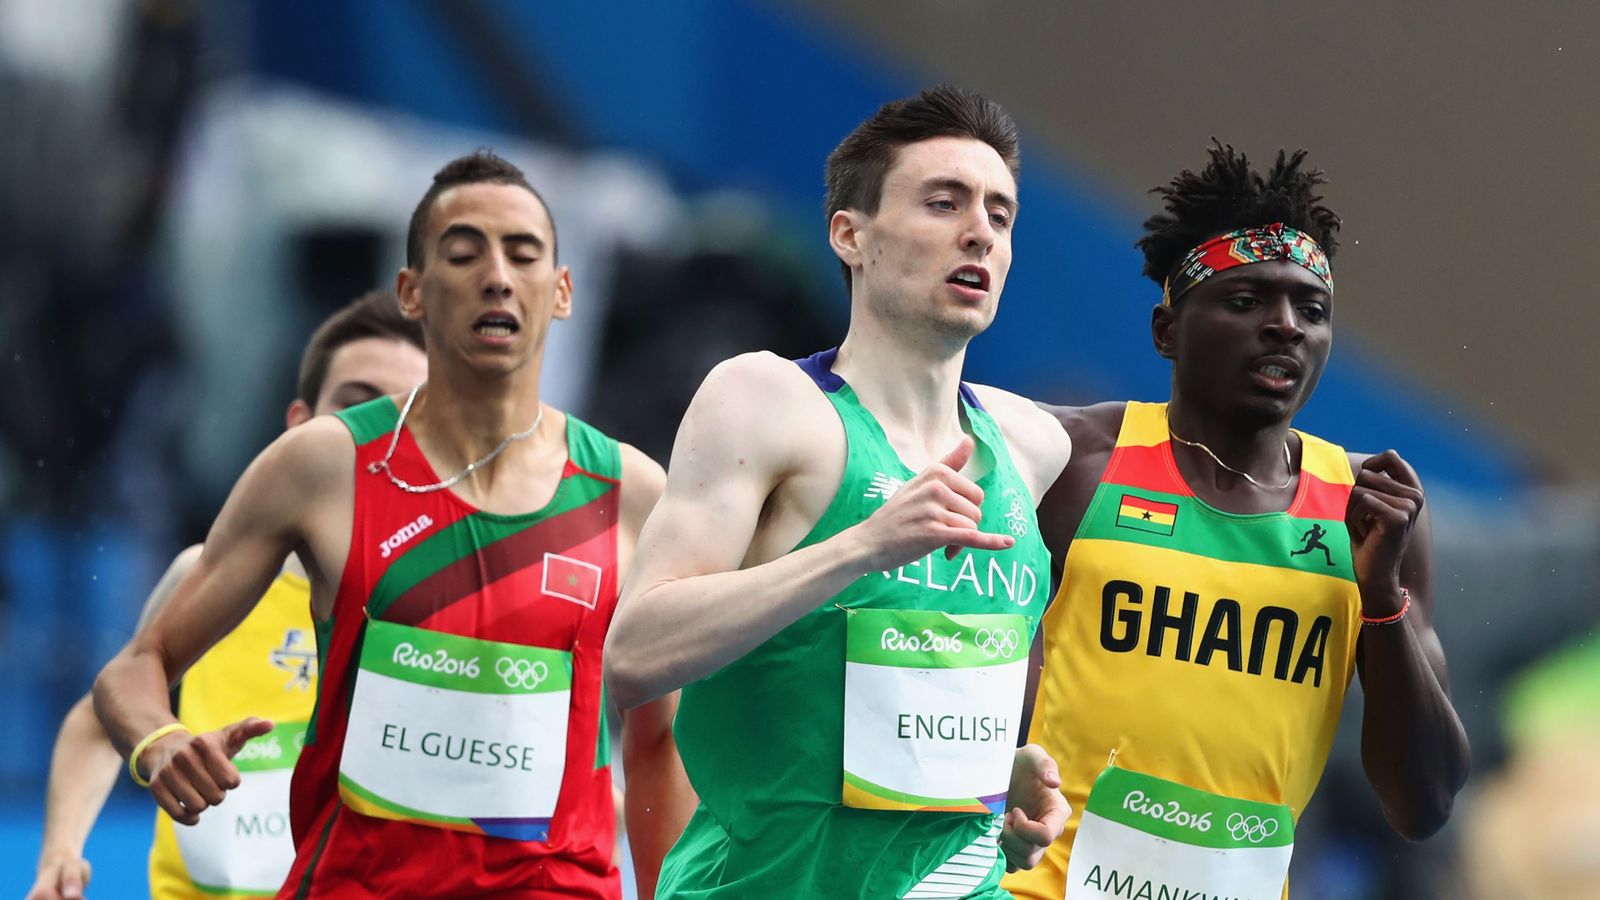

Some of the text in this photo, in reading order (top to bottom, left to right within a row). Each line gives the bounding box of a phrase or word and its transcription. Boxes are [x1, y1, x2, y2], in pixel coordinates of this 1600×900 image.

[863, 551, 1037, 607] ELAND
[880, 627, 964, 652] Rio2016
[1100, 579, 1332, 688] GHANA
[393, 642, 481, 678] Rio2016
[897, 713, 1007, 742] ENGLISH
[381, 724, 535, 771] EL GUESSE
[236, 811, 290, 836] MO
[1122, 789, 1213, 832] Rio2016
